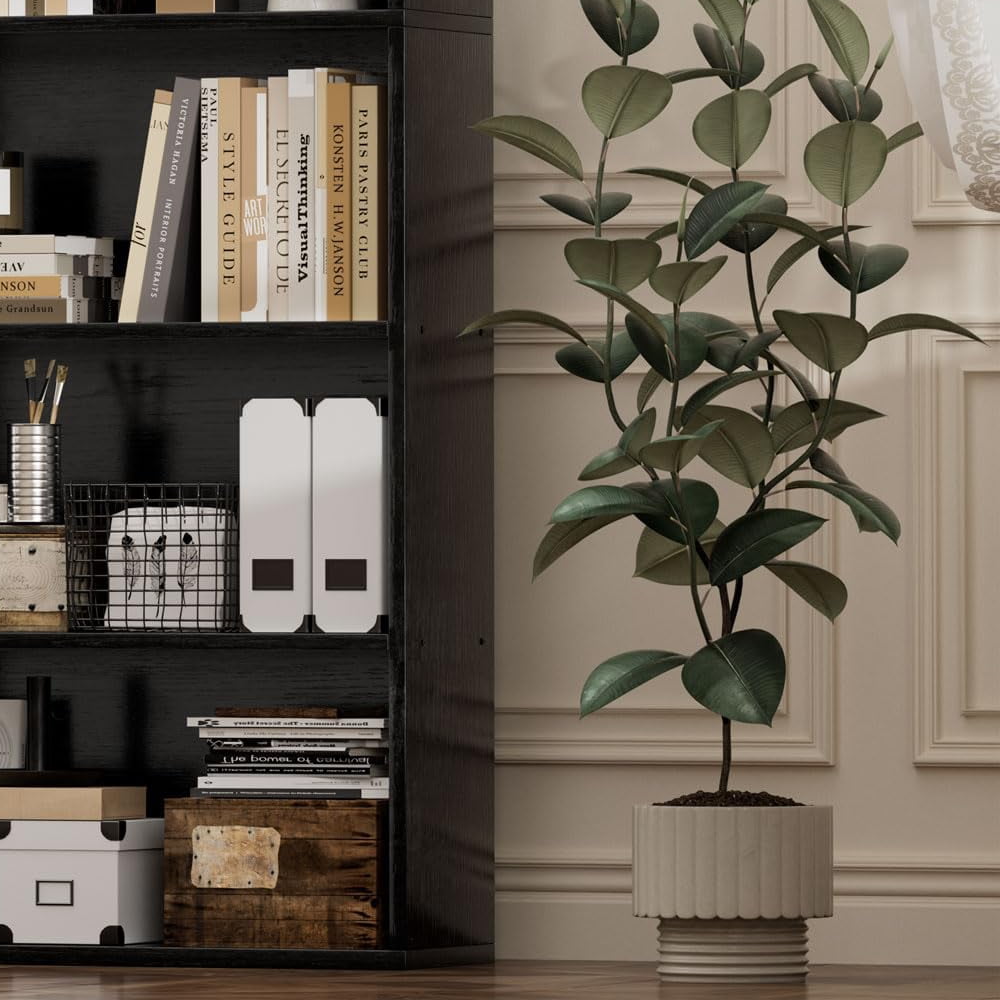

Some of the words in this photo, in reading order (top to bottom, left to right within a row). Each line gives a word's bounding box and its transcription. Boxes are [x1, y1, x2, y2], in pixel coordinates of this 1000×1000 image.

[174, 98, 190, 147] VICTORIA
[209, 88, 218, 127] PAUL
[358, 109, 368, 158] PARIS
[169, 150, 181, 185] HAGAN
[223, 132, 235, 202] STYLE
[333, 124, 344, 193] KONSTEN
[159, 198, 173, 243] INTERIOR
[244, 199, 263, 217] ART
[358, 165, 368, 228] PASTRY
[150, 246, 165, 298] PORTRAITS
[223, 213, 235, 285] GUIDE
[331, 204, 344, 296] H.W.JANSON
[358, 235, 368, 279] CLUB
[6, 304, 54, 313] Grandsun
